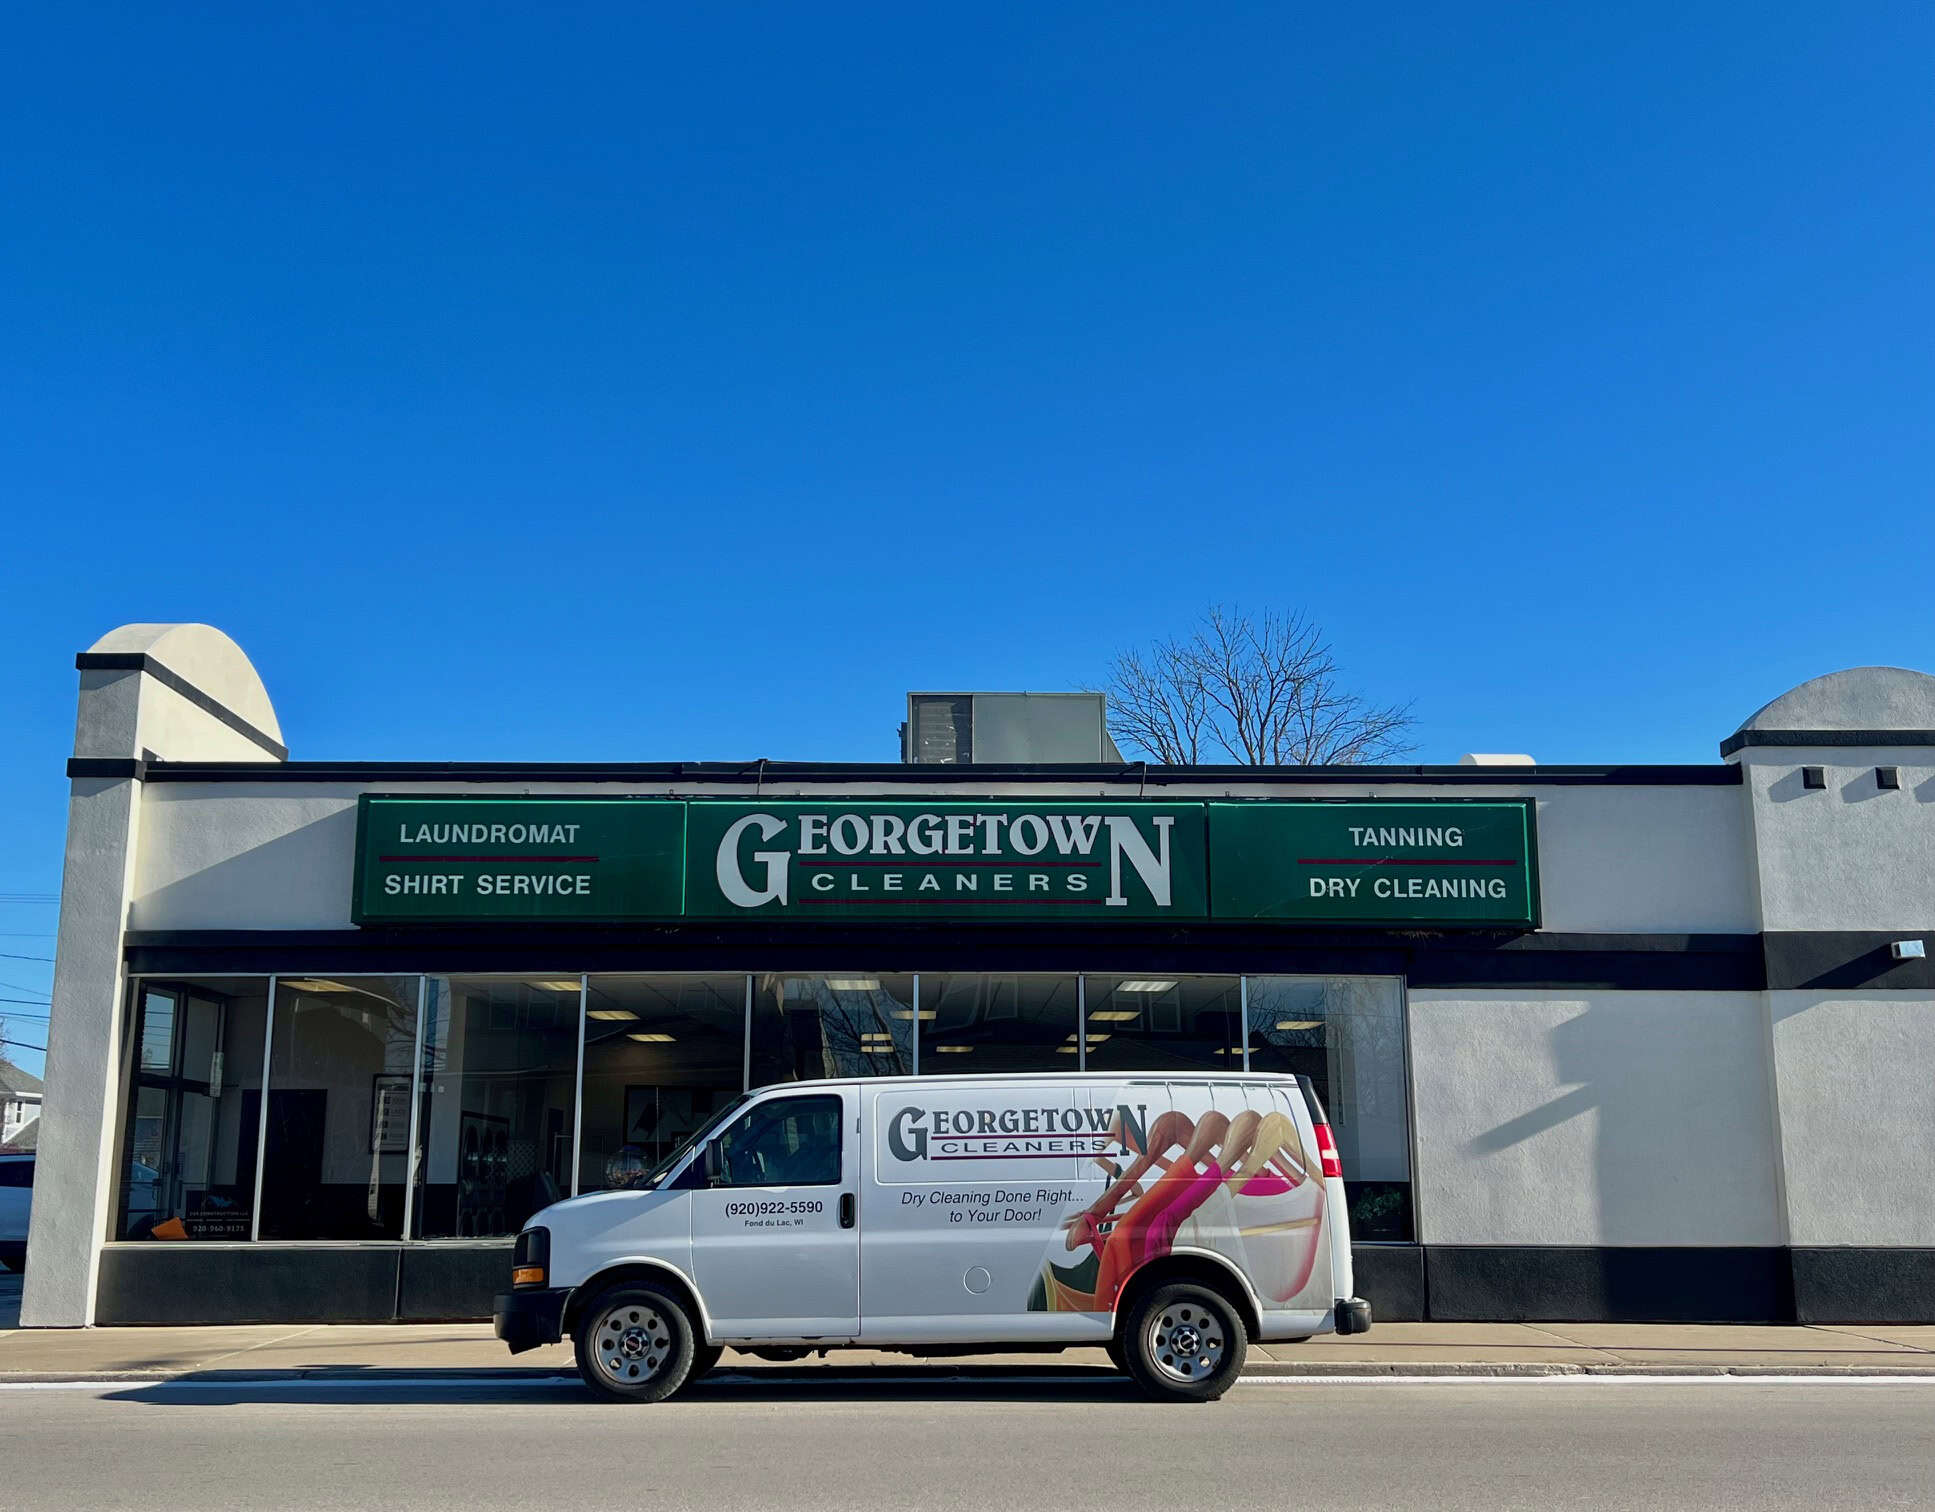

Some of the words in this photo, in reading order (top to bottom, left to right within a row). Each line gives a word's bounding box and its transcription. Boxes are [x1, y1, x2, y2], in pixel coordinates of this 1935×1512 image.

[400, 823, 580, 844] LAUNDROMAT
[1349, 827, 1463, 847] TANNING
[716, 813, 1175, 908] GEORGETOWN
[384, 875, 464, 895] SHIRT
[477, 875, 591, 895] SERVICE
[811, 873, 1088, 891] CLEANERS
[1310, 878, 1360, 897] DRY
[1373, 878, 1506, 898] CLEANING
[888, 1104, 1148, 1162] GEORGETOWN
[941, 1140, 1107, 1153] CLEANERS
[901, 1192, 926, 1208] Dry
[929, 1190, 990, 1206] Cleaning
[994, 1190, 1032, 1203] Done
[1036, 1189, 1084, 1205] Right...
[725, 1200, 823, 1218] (920)922-5590
[950, 1210, 963, 1222] to
[967, 1210, 1000, 1222] Your
[1003, 1208, 1042, 1222] Door!
[744, 1219, 764, 1227] Fond
[765, 1219, 775, 1227] du
[776, 1219, 792, 1228] Lac,
[794, 1218, 804, 1226] WI
